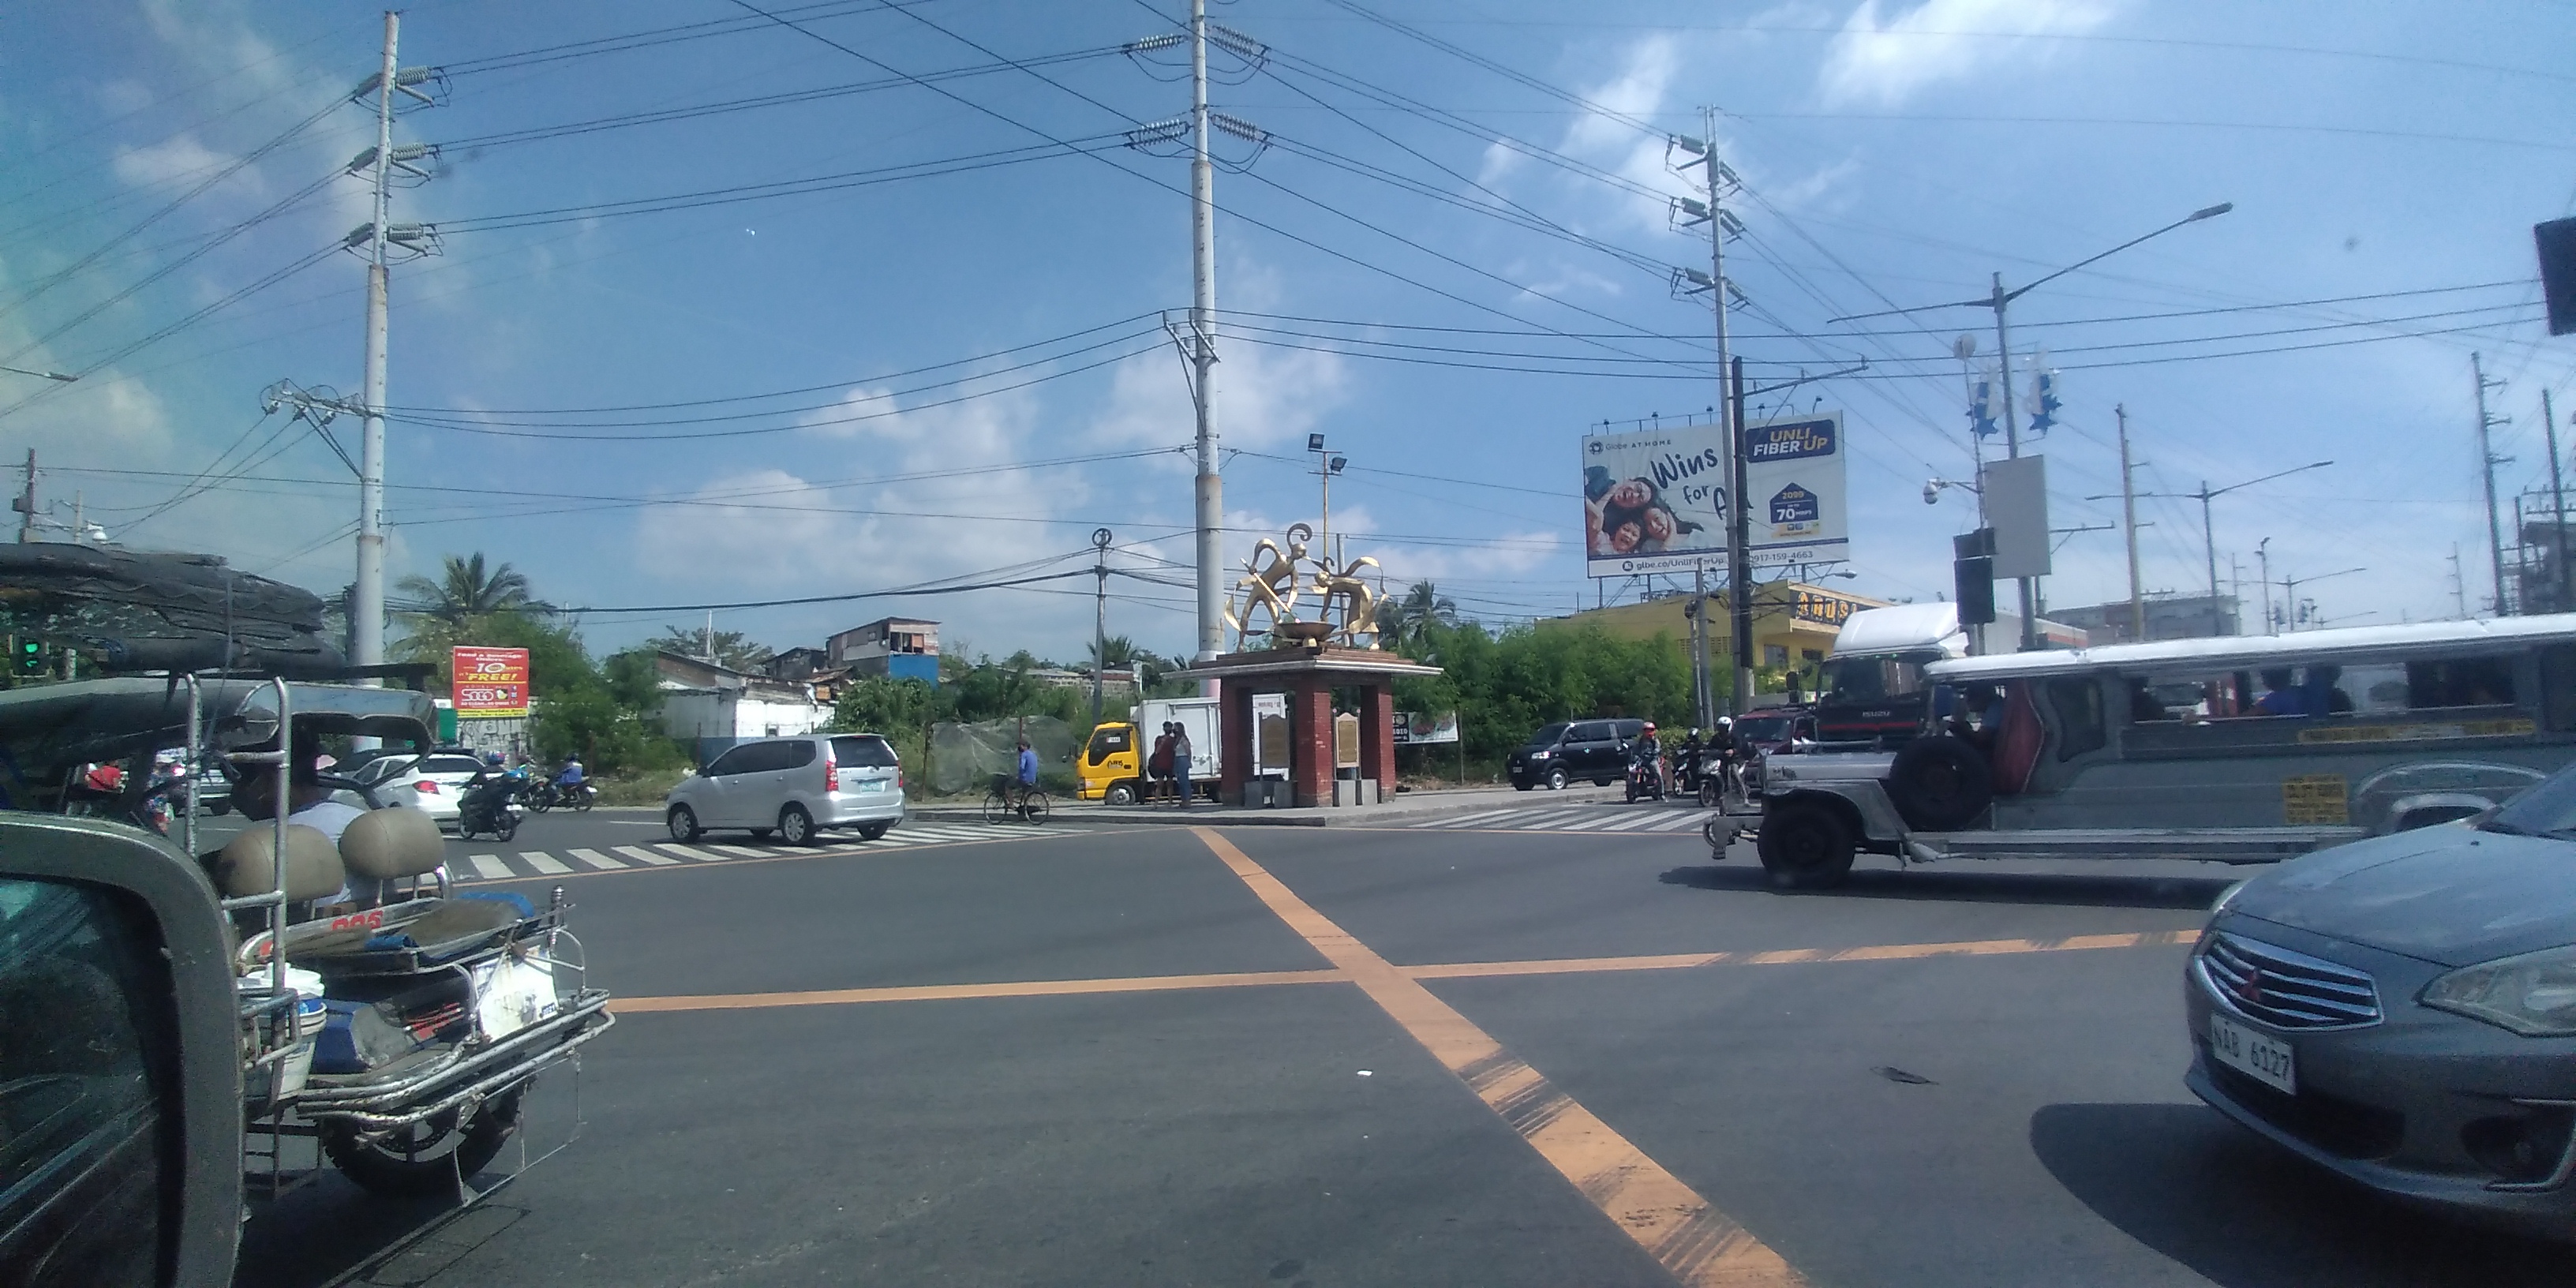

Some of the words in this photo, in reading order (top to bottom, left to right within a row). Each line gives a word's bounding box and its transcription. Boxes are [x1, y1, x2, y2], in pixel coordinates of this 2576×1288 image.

[1770, 427, 1810, 442] UNLI
[1645, 439, 1672, 447] HOME
[1753, 440, 1800, 456] FIBER
[1650, 447, 1718, 489] Wins
[1683, 485, 1709, 505] for
[1777, 508, 1795, 521] 70
[1636, 557, 1724, 571] glbe.co/UnliFierUp
[2213, 1027, 2240, 1058] NAB
[2250, 1041, 2290, 1081] 6127
